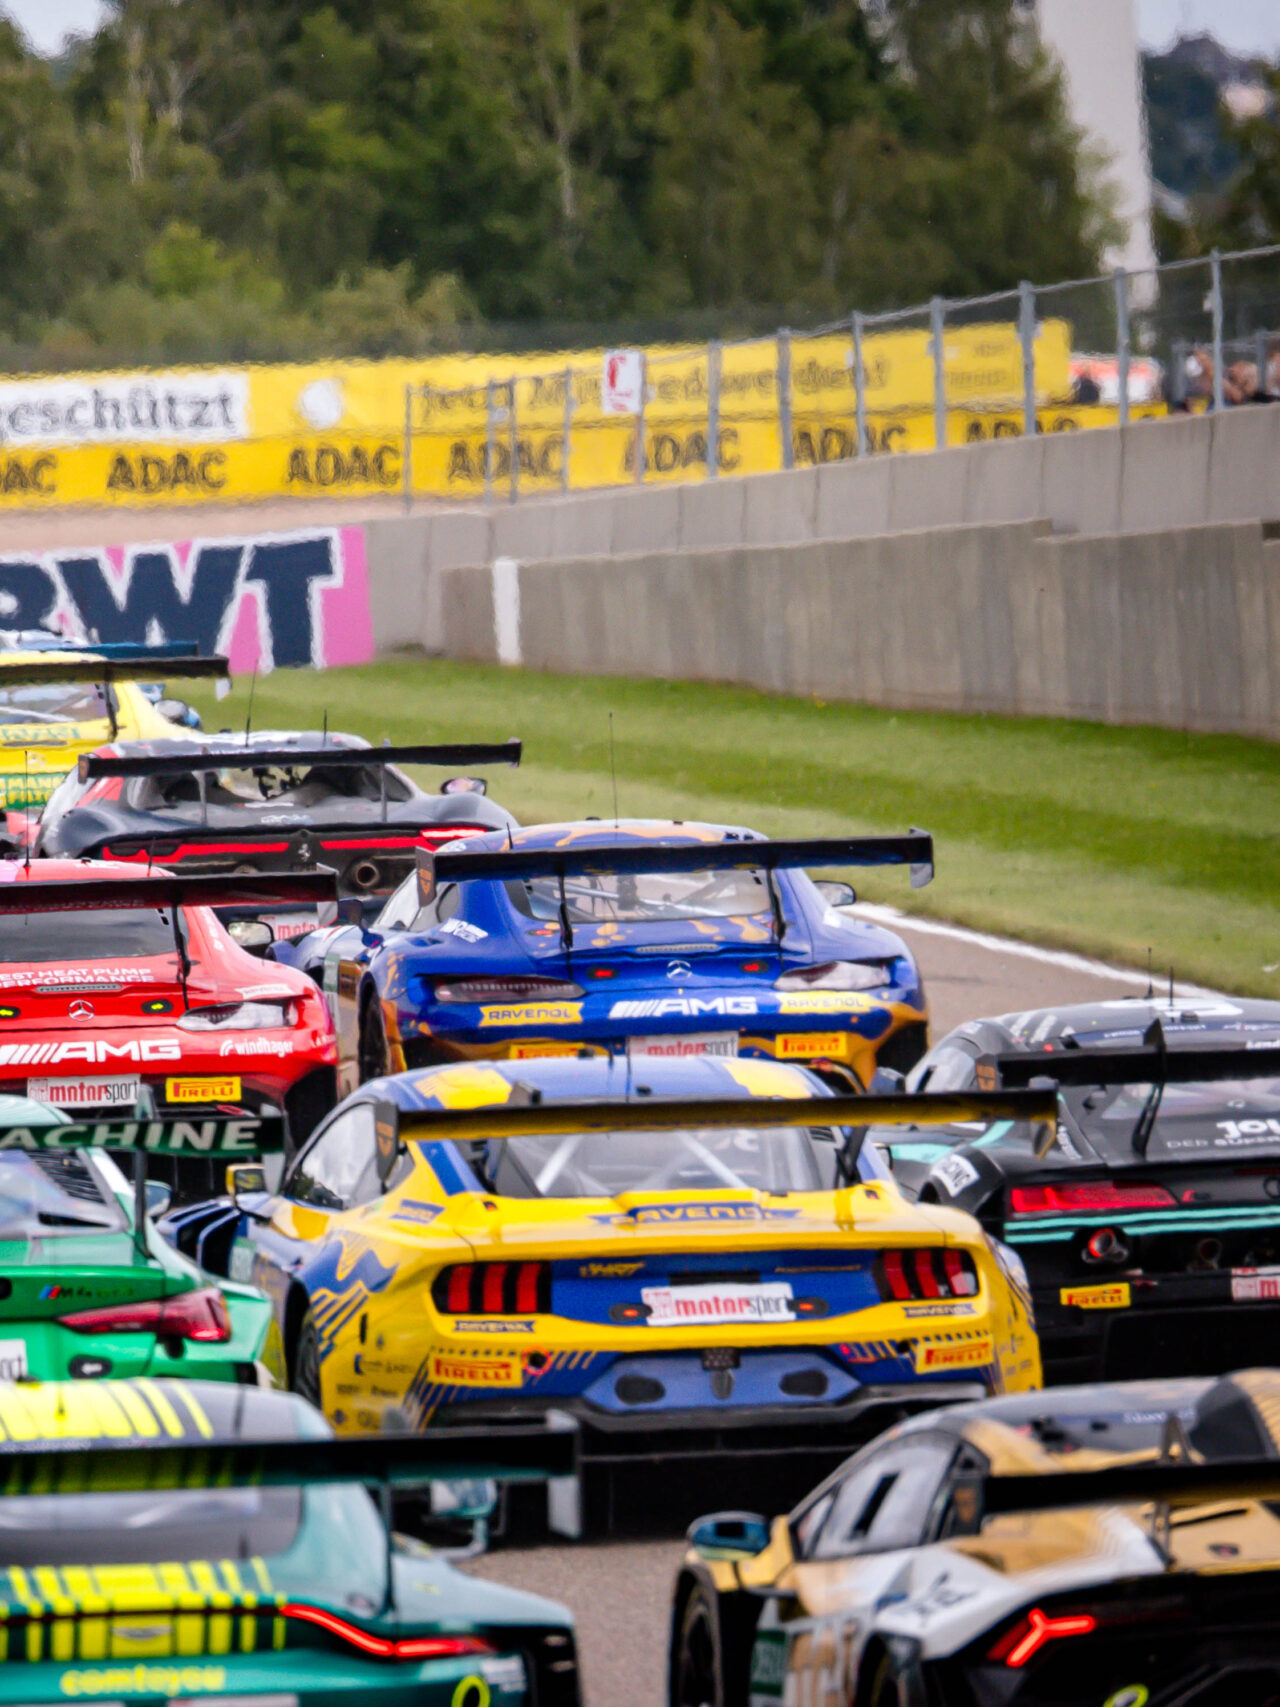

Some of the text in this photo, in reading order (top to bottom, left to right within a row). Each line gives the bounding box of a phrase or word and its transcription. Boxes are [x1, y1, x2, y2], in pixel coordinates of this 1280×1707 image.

[106, 450, 227, 494] ADAC
[286, 445, 401, 486] ADAC
[37, 968, 90, 979] HEAT
[92, 967, 153, 977] PUMP
[488, 1007, 570, 1021] RAVENOL
[654, 996, 758, 1017] AMG
[50, 1038, 182, 1063] AMG
[234, 1036, 293, 1058] windhager
[49, 1080, 139, 1104] motorsport
[173, 1081, 234, 1098] PIRELLI
[924, 1341, 990, 1366] PIRELLI
[434, 1358, 512, 1380] PIRELLI
[59, 1663, 227, 1698] comtoyou
